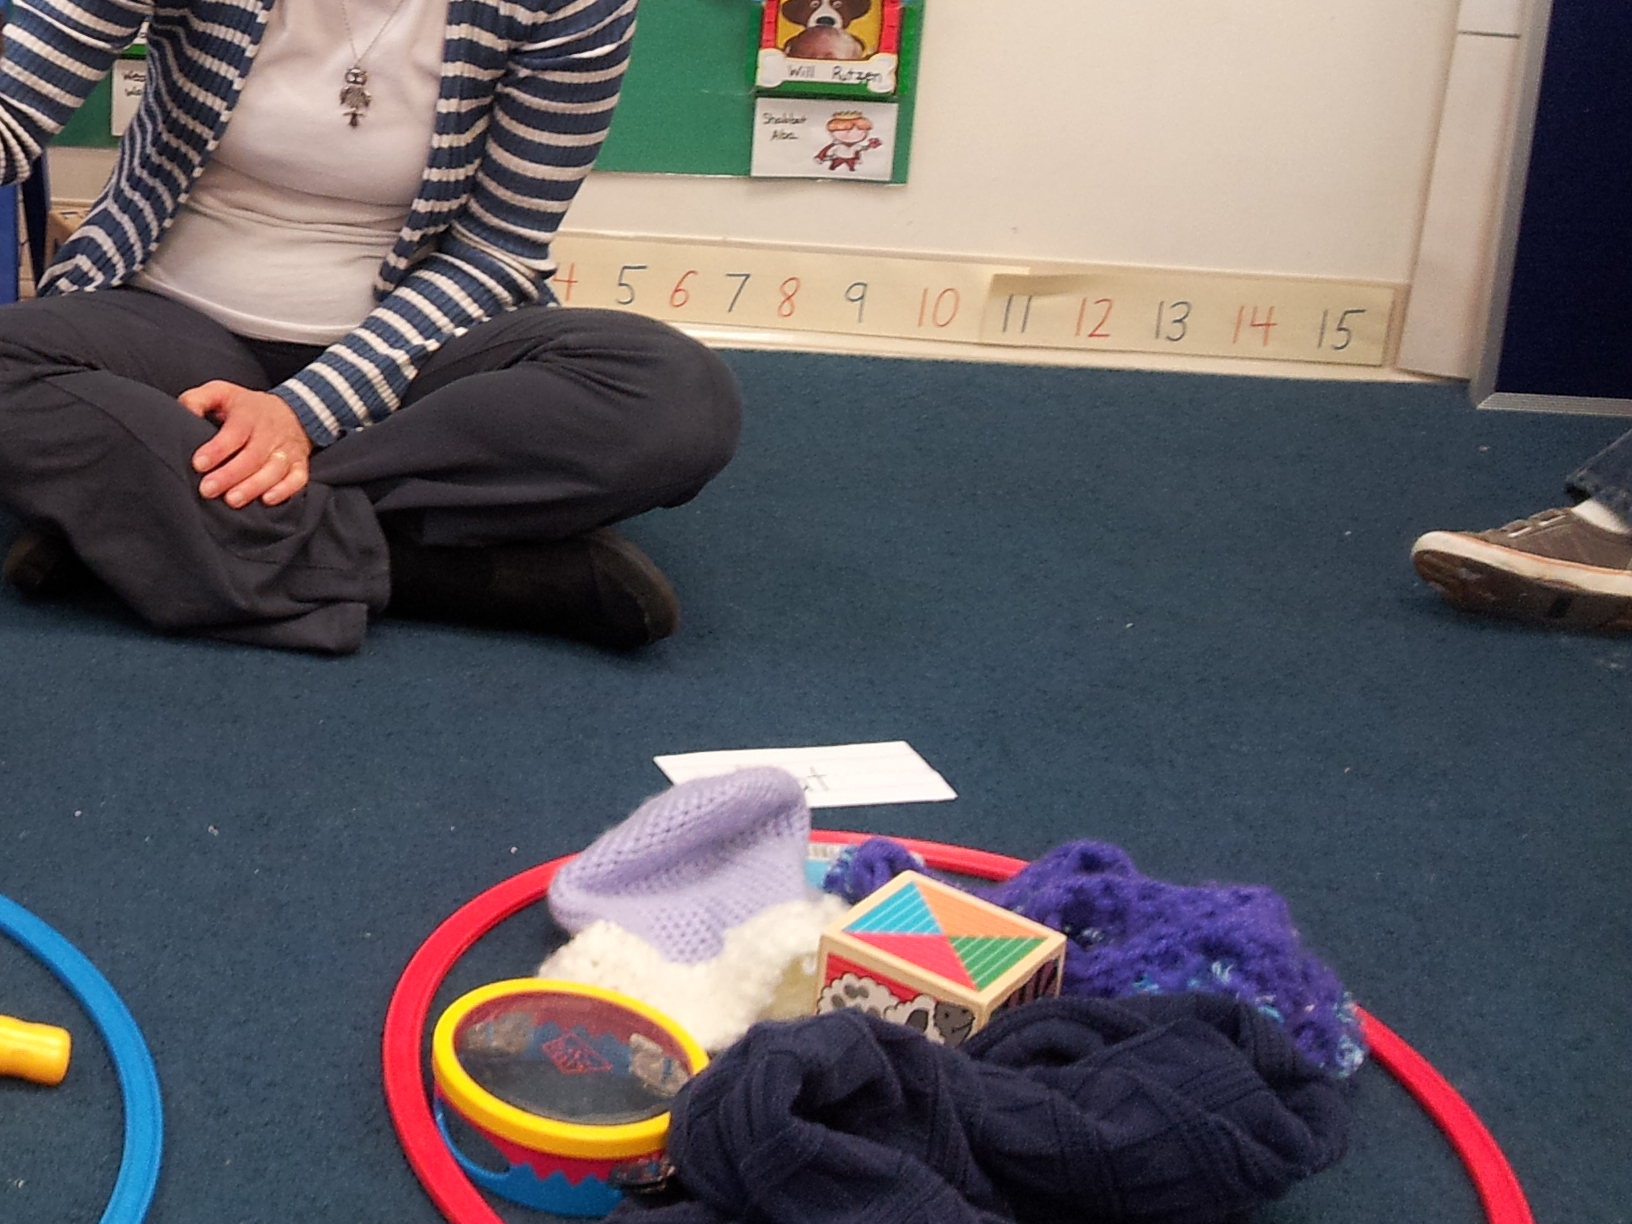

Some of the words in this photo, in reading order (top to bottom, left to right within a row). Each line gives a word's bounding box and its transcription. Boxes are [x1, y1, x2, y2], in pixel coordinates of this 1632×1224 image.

[788, 66, 815, 79] Will
[552, 263, 578, 301] 4
[616, 265, 648, 305] 5
[670, 270, 698, 307] 6
[725, 273, 751, 313] 7
[777, 276, 801, 318] 8
[845, 282, 868, 323] 9
[918, 287, 960, 328] 10
[1002, 294, 1034, 334] 11
[1075, 297, 1114, 338] 12
[1155, 300, 1192, 342] 13
[1232, 305, 1277, 346] 14
[1318, 308, 1365, 350] 15
